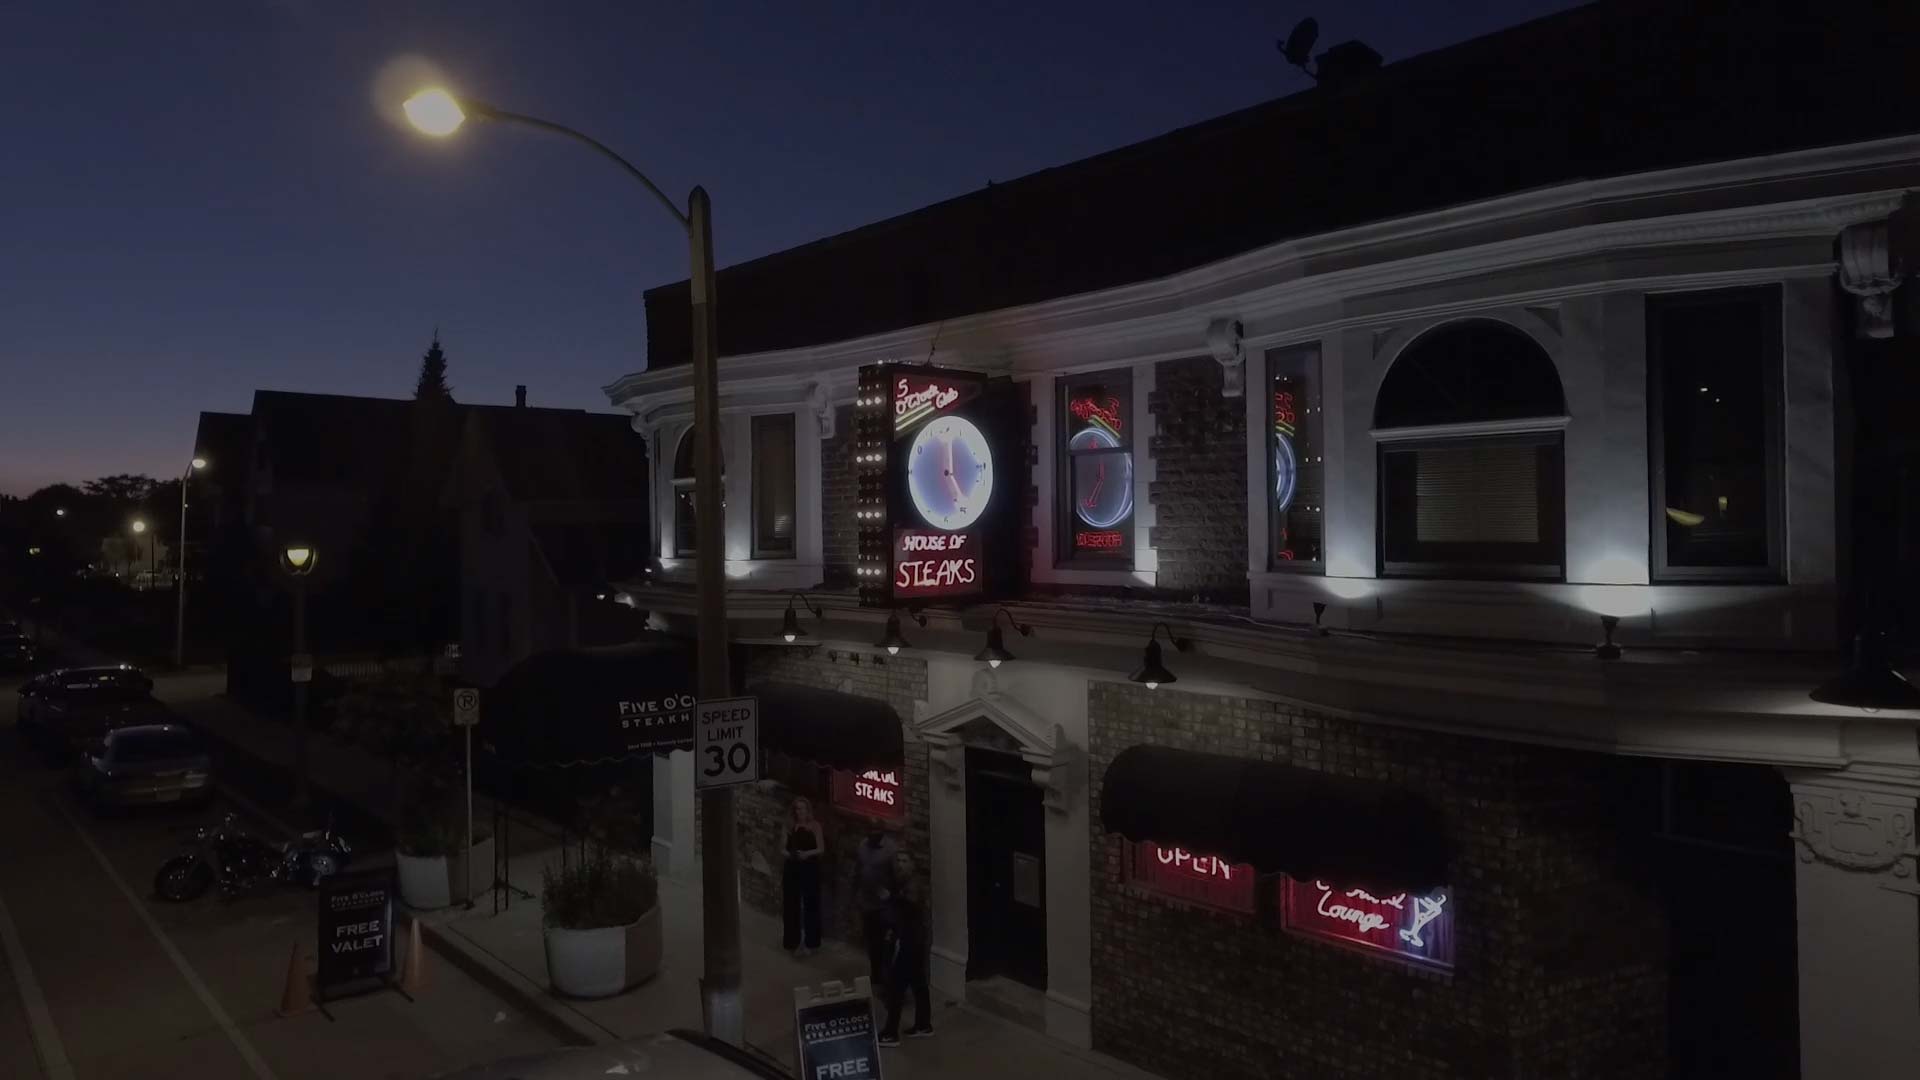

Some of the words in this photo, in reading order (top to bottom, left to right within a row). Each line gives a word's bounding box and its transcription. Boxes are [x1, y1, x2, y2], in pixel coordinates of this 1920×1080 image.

[897, 378, 909, 398] 5
[902, 535, 946, 551] HOUSE
[948, 534, 967, 549] OF
[896, 558, 975, 588] STEAKS
[618, 700, 659, 715] FIVE
[663, 692, 697, 710] O'C
[621, 712, 690, 729] STEAKH
[702, 708, 751, 725] SPEED
[707, 726, 744, 742] LIMIT
[703, 742, 751, 777] 30
[855, 782, 895, 805] STEAKS
[1317, 890, 1390, 933] Lounge
[336, 919, 380, 938] FREE
[330, 934, 384, 953] VALET
[804, 1022, 827, 1032] FIVE
[815, 1057, 870, 1080] FREE
